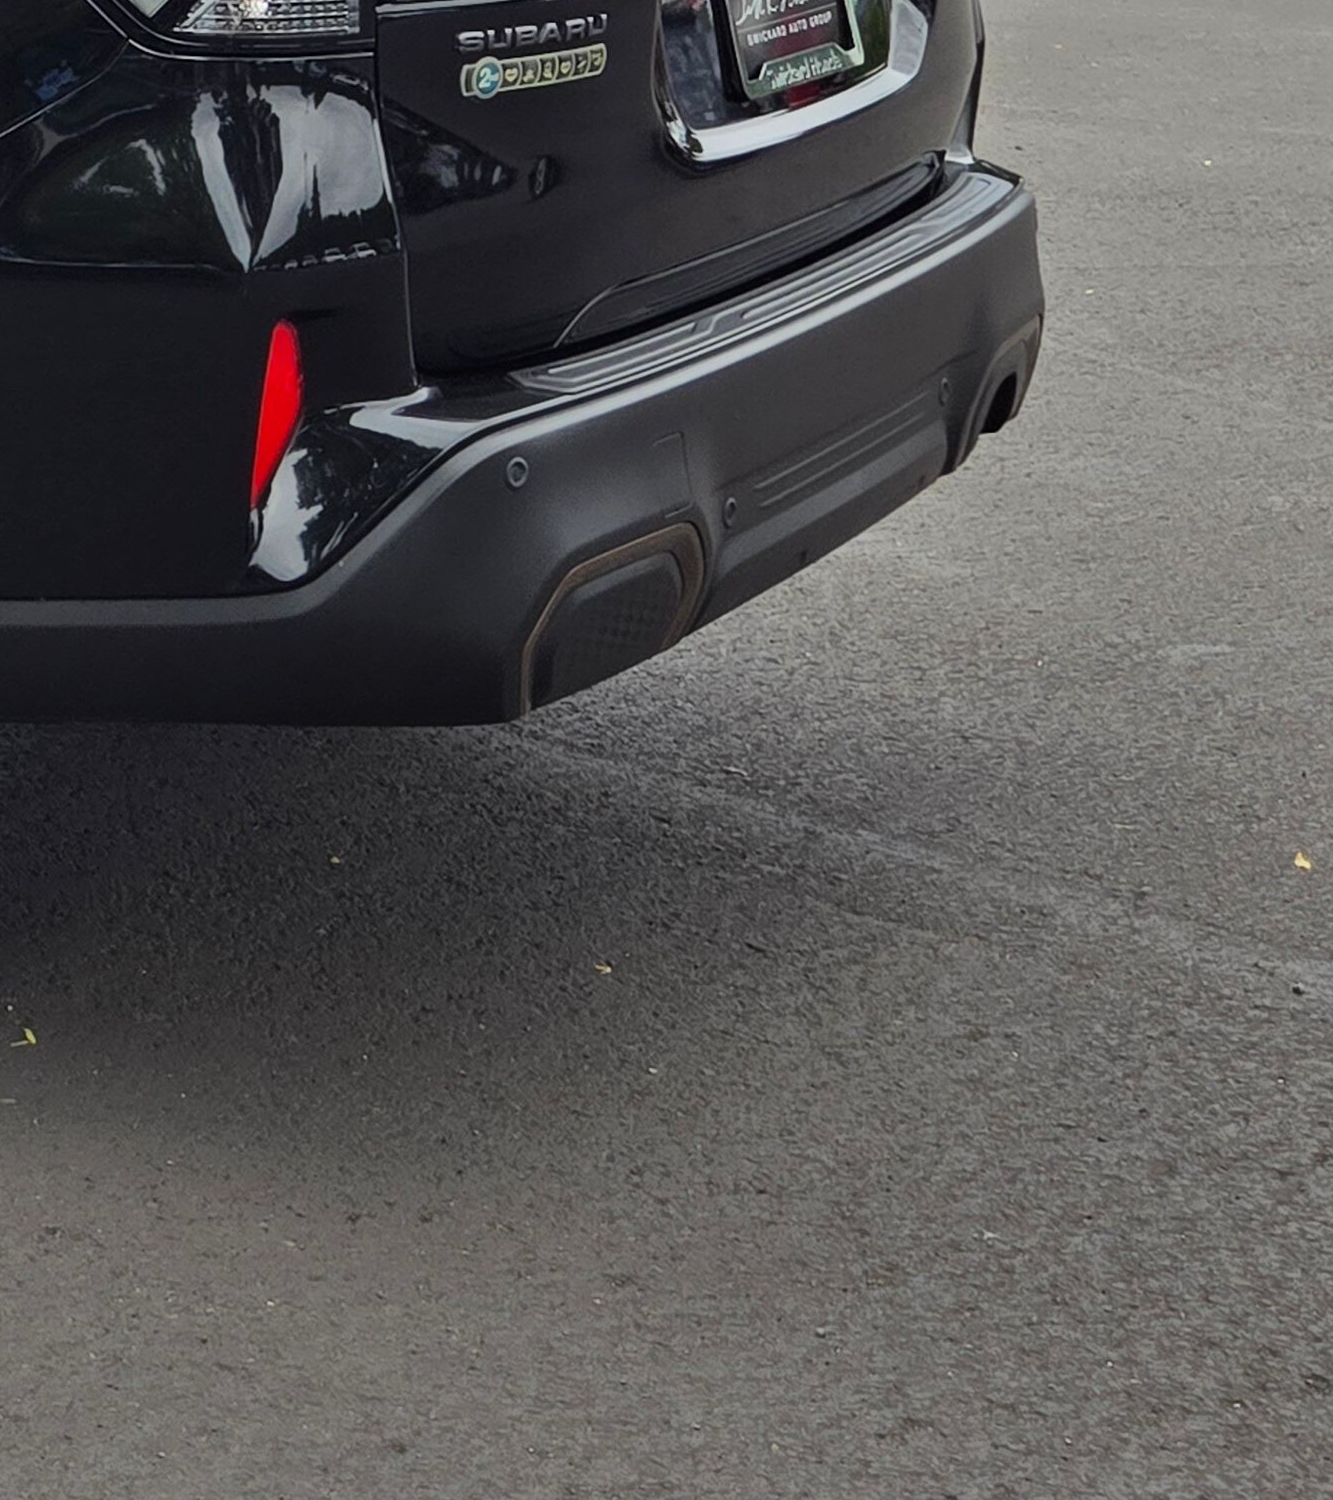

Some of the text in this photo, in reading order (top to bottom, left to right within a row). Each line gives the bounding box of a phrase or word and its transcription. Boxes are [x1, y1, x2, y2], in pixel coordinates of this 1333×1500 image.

[455, 13, 608, 53] SUBARU
[788, 18, 808, 35] AUTO
[810, 11, 832, 29] GROUP
